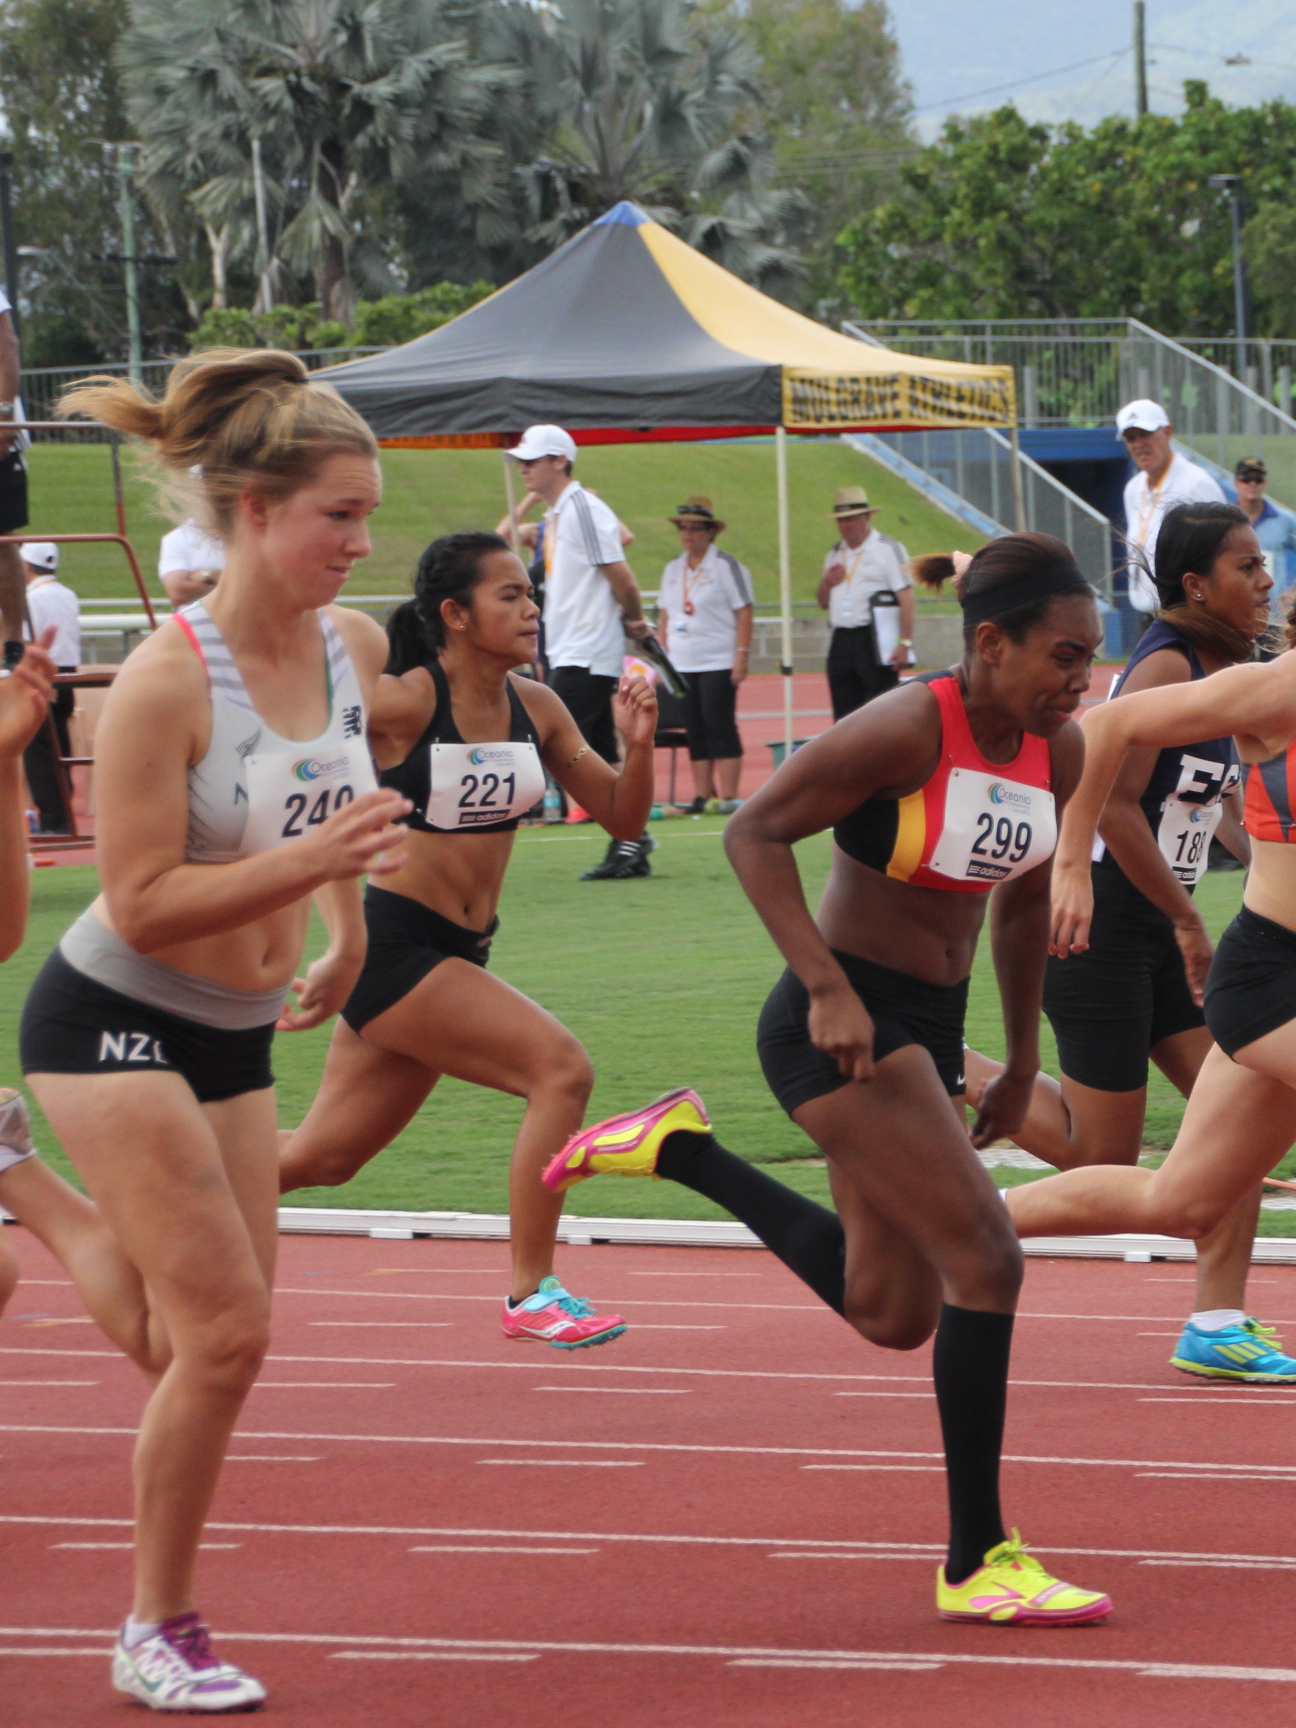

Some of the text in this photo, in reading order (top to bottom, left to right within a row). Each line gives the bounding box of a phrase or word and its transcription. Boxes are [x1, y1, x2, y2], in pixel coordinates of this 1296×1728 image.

[478, 748, 514, 760] Oceania
[310, 756, 349, 775] Oceania
[458, 772, 515, 808] 221
[998, 787, 1032, 806] Oceania
[971, 811, 1033, 864] 299
[980, 866, 1008, 879] adidas
